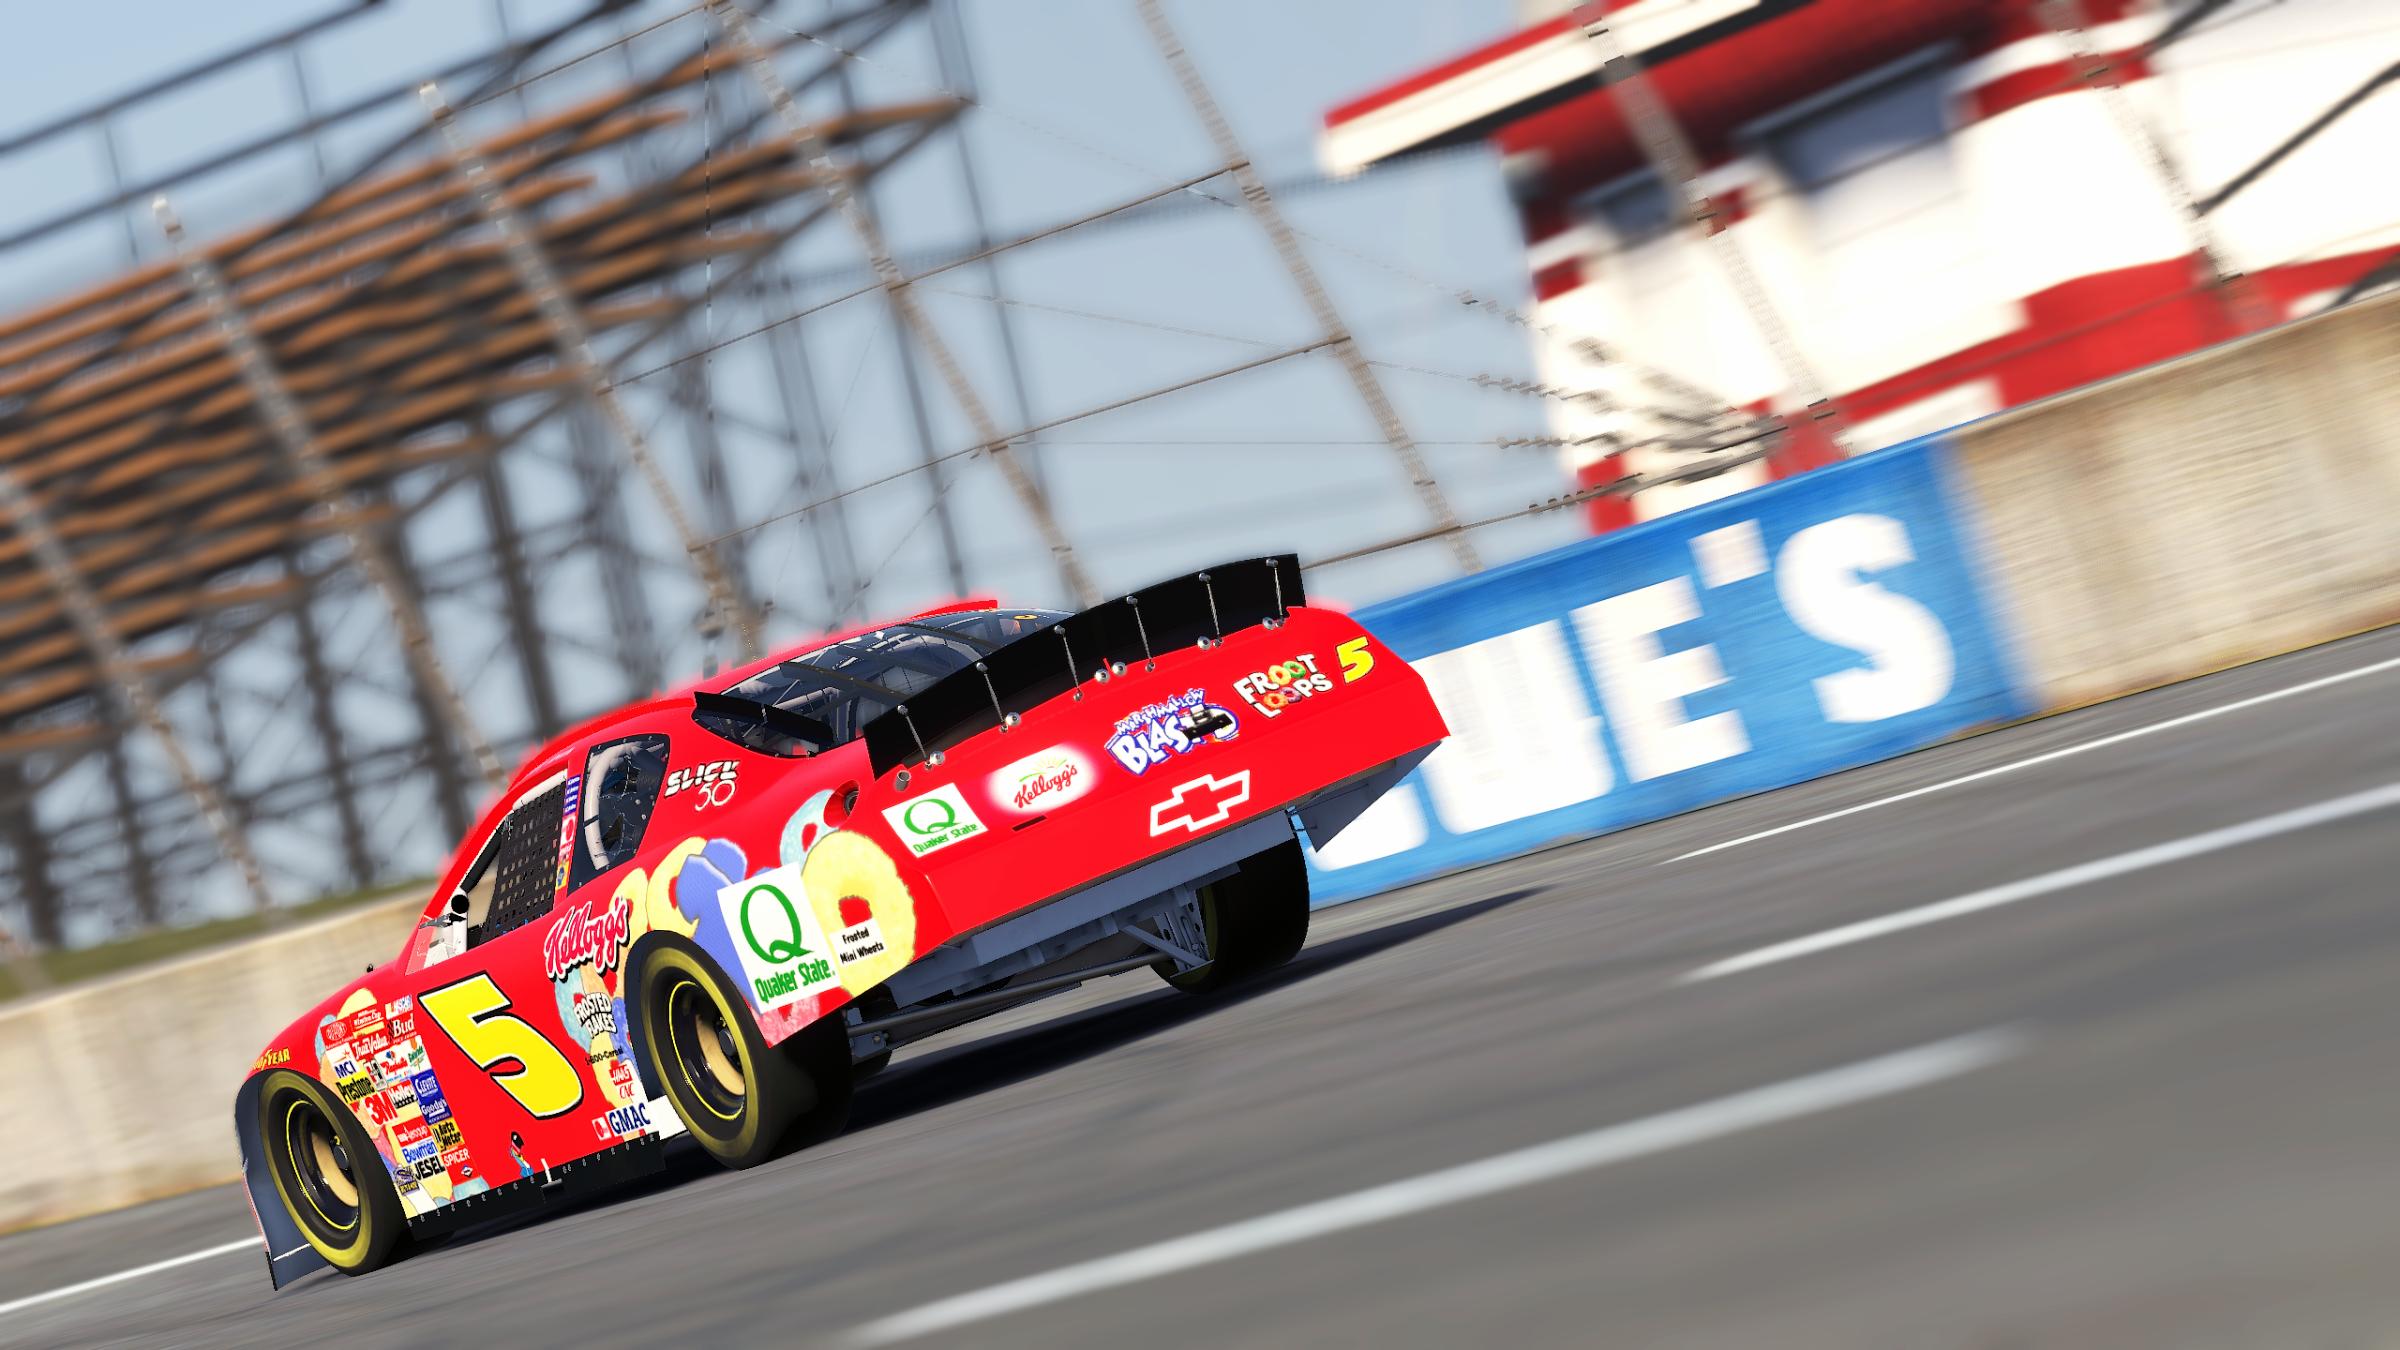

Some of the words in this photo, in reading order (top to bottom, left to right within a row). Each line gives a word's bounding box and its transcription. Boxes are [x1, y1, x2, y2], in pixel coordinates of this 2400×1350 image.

[1335, 635, 1376, 684] 5
[1232, 653, 1318, 705] FROOT
[1308, 512, 1957, 872] WE'S
[1253, 673, 1334, 718] LOOPS
[664, 760, 741, 797] SLICK
[1013, 764, 1078, 808] Kellogg's
[694, 779, 736, 811] 50
[914, 833, 948, 853] Quaker
[951, 822, 978, 838] State
[543, 895, 630, 983] Kellogg's
[842, 927, 870, 944] Frosted
[839, 951, 857, 964] Mini
[858, 940, 885, 959] Wheats
[755, 965, 797, 1004] Quaker
[799, 958, 831, 985] State
[392, 1012, 415, 1038] Bud
[573, 992, 613, 1027] FROSTED
[585, 1012, 618, 1040] FLAKES
[417, 969, 584, 1121] 5
[334, 1060, 357, 1078] MCI
[335, 1077, 375, 1104] Prestone
[388, 1083, 418, 1104] Holley
[619, 1082, 635, 1099] CNC
[364, 1091, 398, 1125] 3M
[421, 1097, 447, 1116] Goody's
[608, 1102, 651, 1135] GMAC
[402, 1141, 438, 1164] Bowman
[414, 1156, 446, 1180] JESEL
[443, 1148, 470, 1167] SPICER
